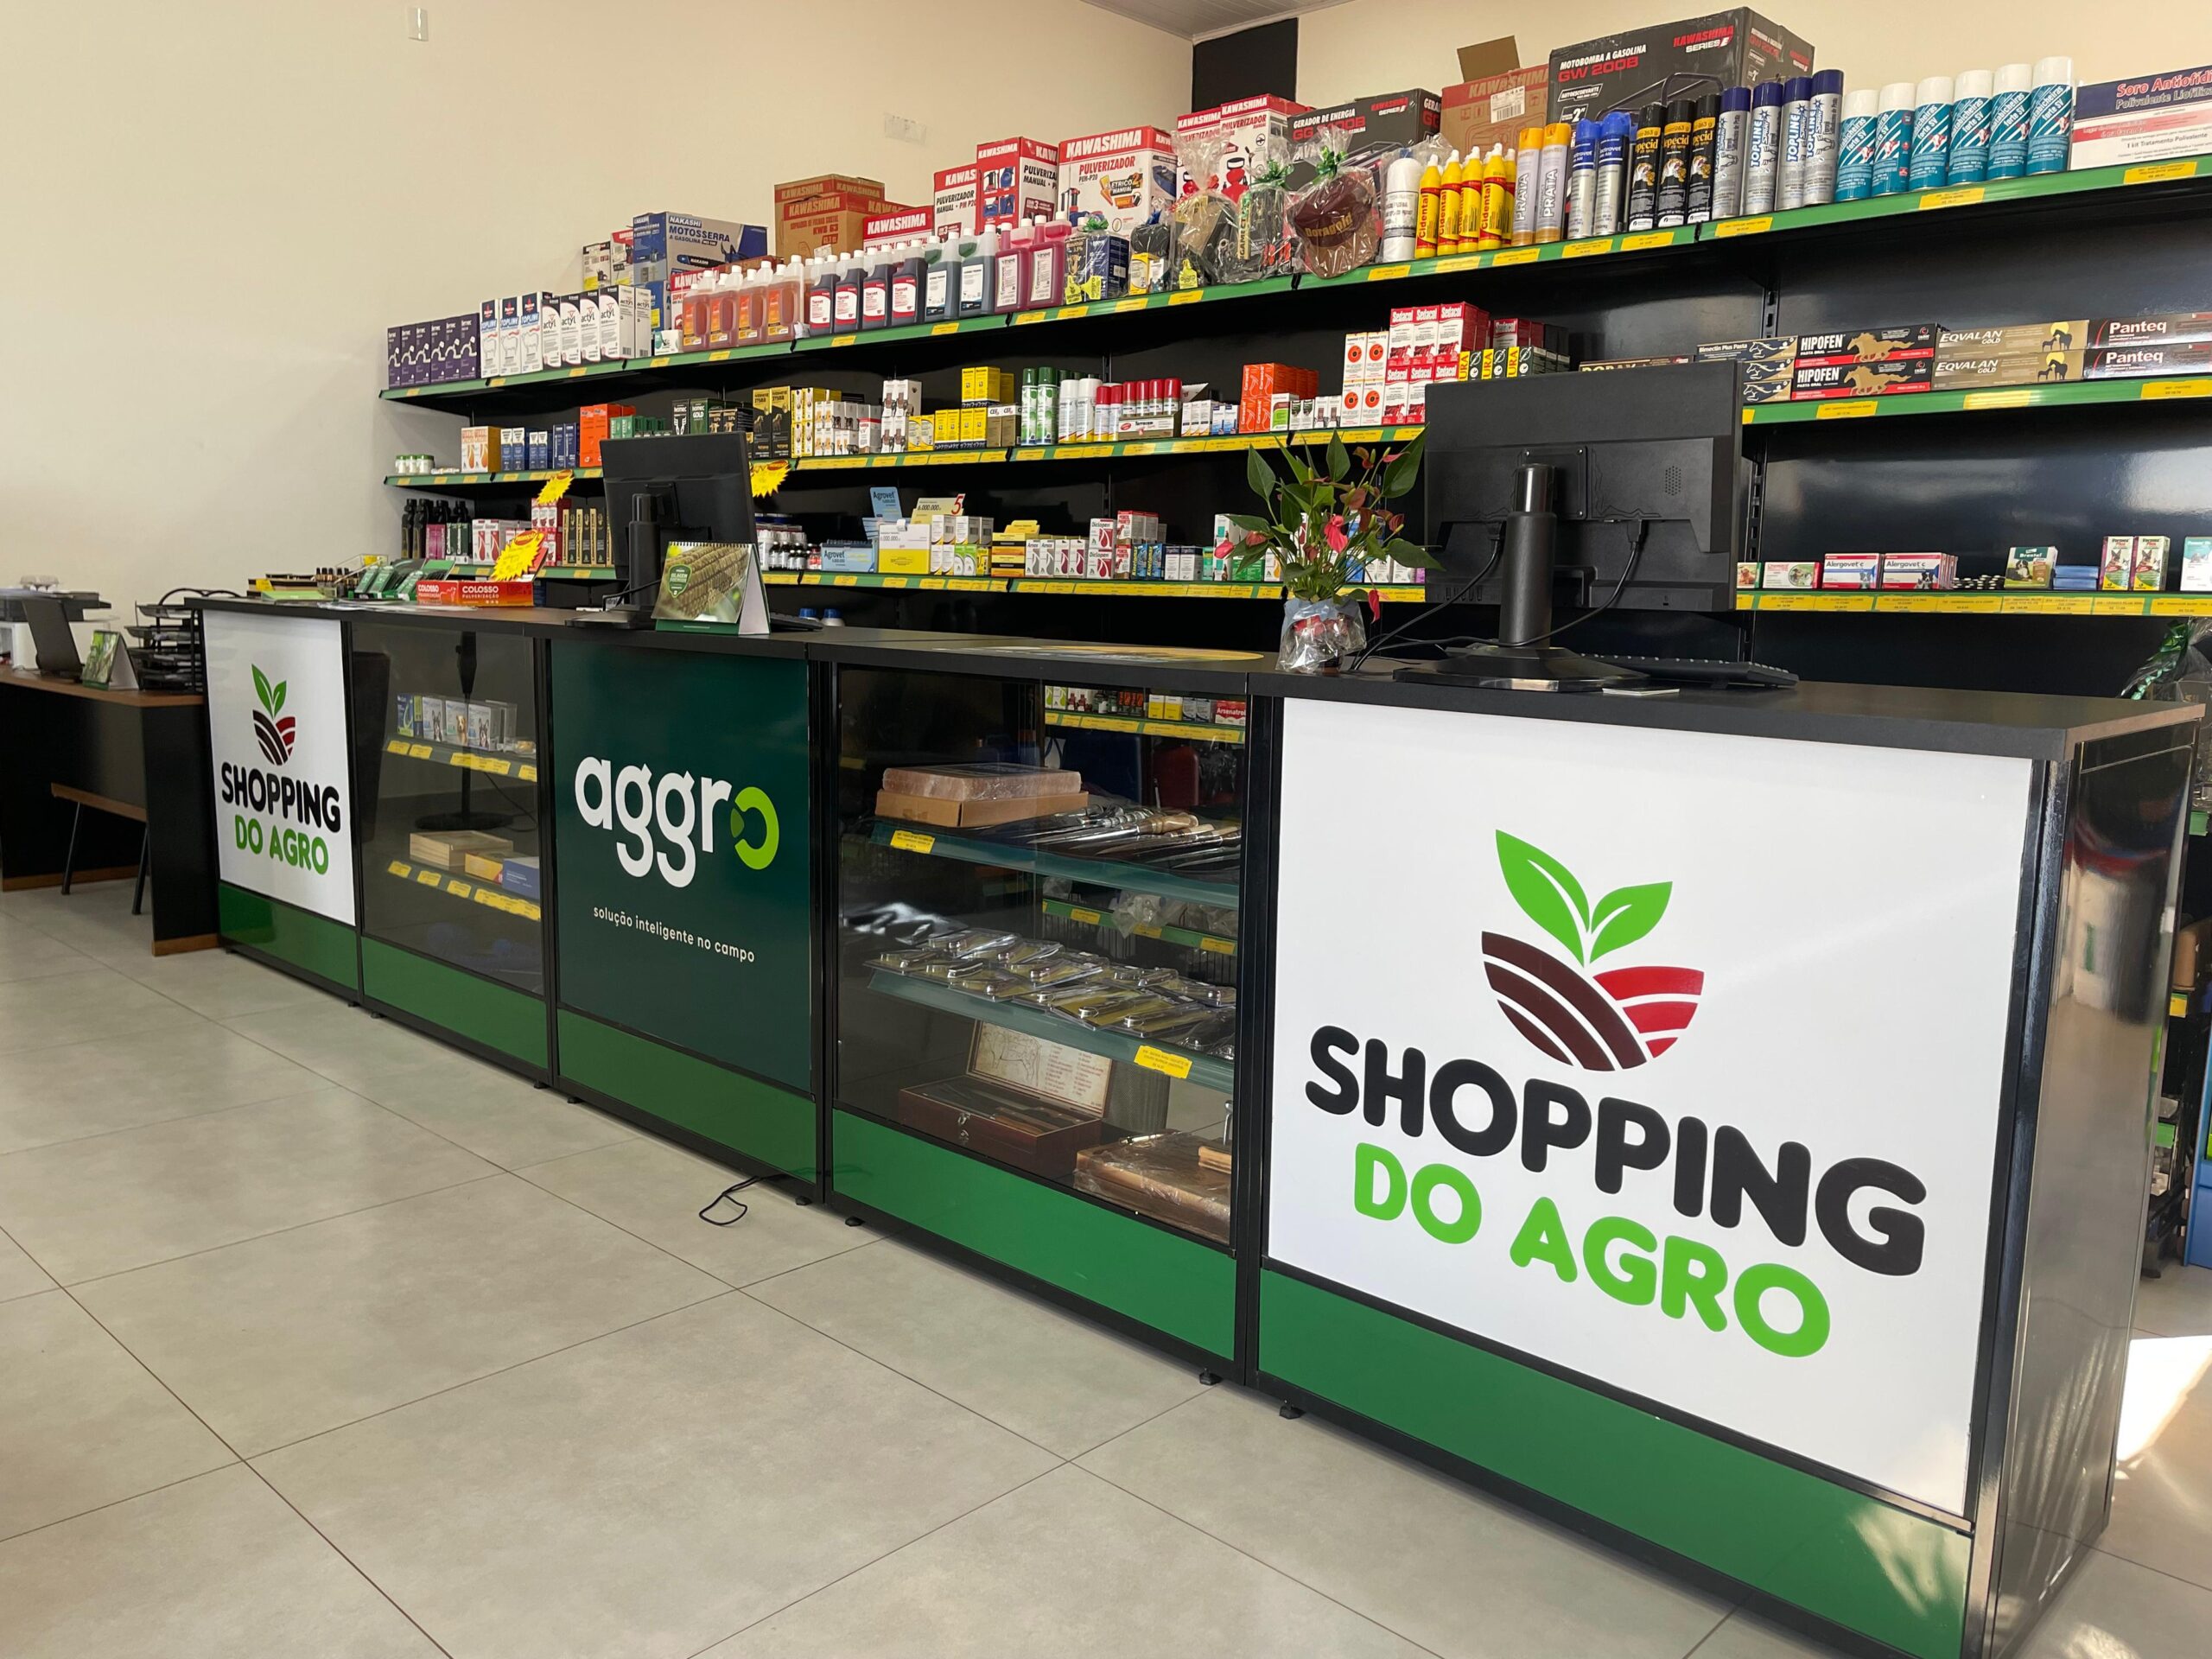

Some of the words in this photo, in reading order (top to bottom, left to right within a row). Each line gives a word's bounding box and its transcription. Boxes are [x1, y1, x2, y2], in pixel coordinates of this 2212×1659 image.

[1673, 25, 1734, 48] KAWASHIMA
[1686, 40, 1719, 53] SERIES
[1560, 53, 1605, 70] MOTOBOMBA
[1605, 53, 1612, 61] A
[1612, 44, 1647, 60] GASOLINA
[1558, 67, 1588, 82] GW
[1470, 68, 1548, 99] KAWASHIMA
[2117, 82, 2149, 97] Soro
[1222, 97, 1268, 115] KAWASHIMA
[2115, 92, 2171, 110] Polivalente
[1178, 111, 1221, 129] KAWASHIMA
[1294, 113, 1320, 129] GERADOR
[1321, 111, 1329, 123] DE
[1331, 108, 1356, 122] ENERGIA
[2003, 111, 2016, 126] forte
[2042, 105, 2055, 121] forte
[1806, 108, 1817, 158] TOPLINE
[1917, 124, 1929, 139] forte
[1962, 118, 1974, 132] forte
[1293, 128, 1314, 140] GG
[1786, 113, 1800, 162] TOPLINE
[1846, 135, 1858, 150] forte
[978, 143, 1018, 159] KAWASHIMA
[1066, 130, 1141, 158] KAWASHIMA
[1751, 119, 1764, 168] TOPLINE
[1079, 156, 1136, 175] PULVERIZADOR
[836, 182, 880, 198] KAWASHIMA
[1023, 176, 1046, 188] MANUAL
[781, 183, 824, 199] KAWASHIMA
[937, 190, 975, 205] PULVERIZADOR
[1514, 173, 1529, 221] PRATA
[1544, 168, 1558, 218] PRATA
[789, 196, 841, 217] KAWASHIMA
[937, 202, 954, 214] MANUAL
[1481, 184, 1491, 229] Cidental
[669, 216, 702, 228] NAKASHI
[868, 213, 926, 235] KAWASHIMA
[1419, 193, 1429, 238] Cidental
[1305, 213, 1353, 238] Doragold
[669, 226, 730, 243] MOTOSSERRA
[674, 235, 702, 245] GASOLINA
[2108, 321, 2167, 334] Panteq
[1801, 334, 1844, 351] HIPOFEN
[1939, 329, 2003, 344] EQVALAN
[1936, 359, 1999, 372] EQVALAN
[2105, 350, 2164, 364] Panteq
[1797, 367, 1840, 384] HIPOFEN
[874, 490, 895, 499] Agrovet
[823, 550, 845, 559] Agrovet
[1827, 560, 1859, 569] Alergovet
[1886, 560, 1919, 569] Alergovet
[417, 584, 440, 593] COLOSSO
[221, 761, 340, 833] SHOPPING
[575, 756, 779, 888] aggro
[234, 814, 264, 855] DO
[270, 825, 329, 875] AGRO
[594, 906, 632, 927] solução
[635, 914, 694, 945] inteligente
[697, 936, 711, 950] no
[715, 940, 755, 963] campo
[1305, 1025, 1927, 1277] SHOPPING
[1353, 1142, 1483, 1245] DO
[1510, 1196, 1831, 1358] AGRO
